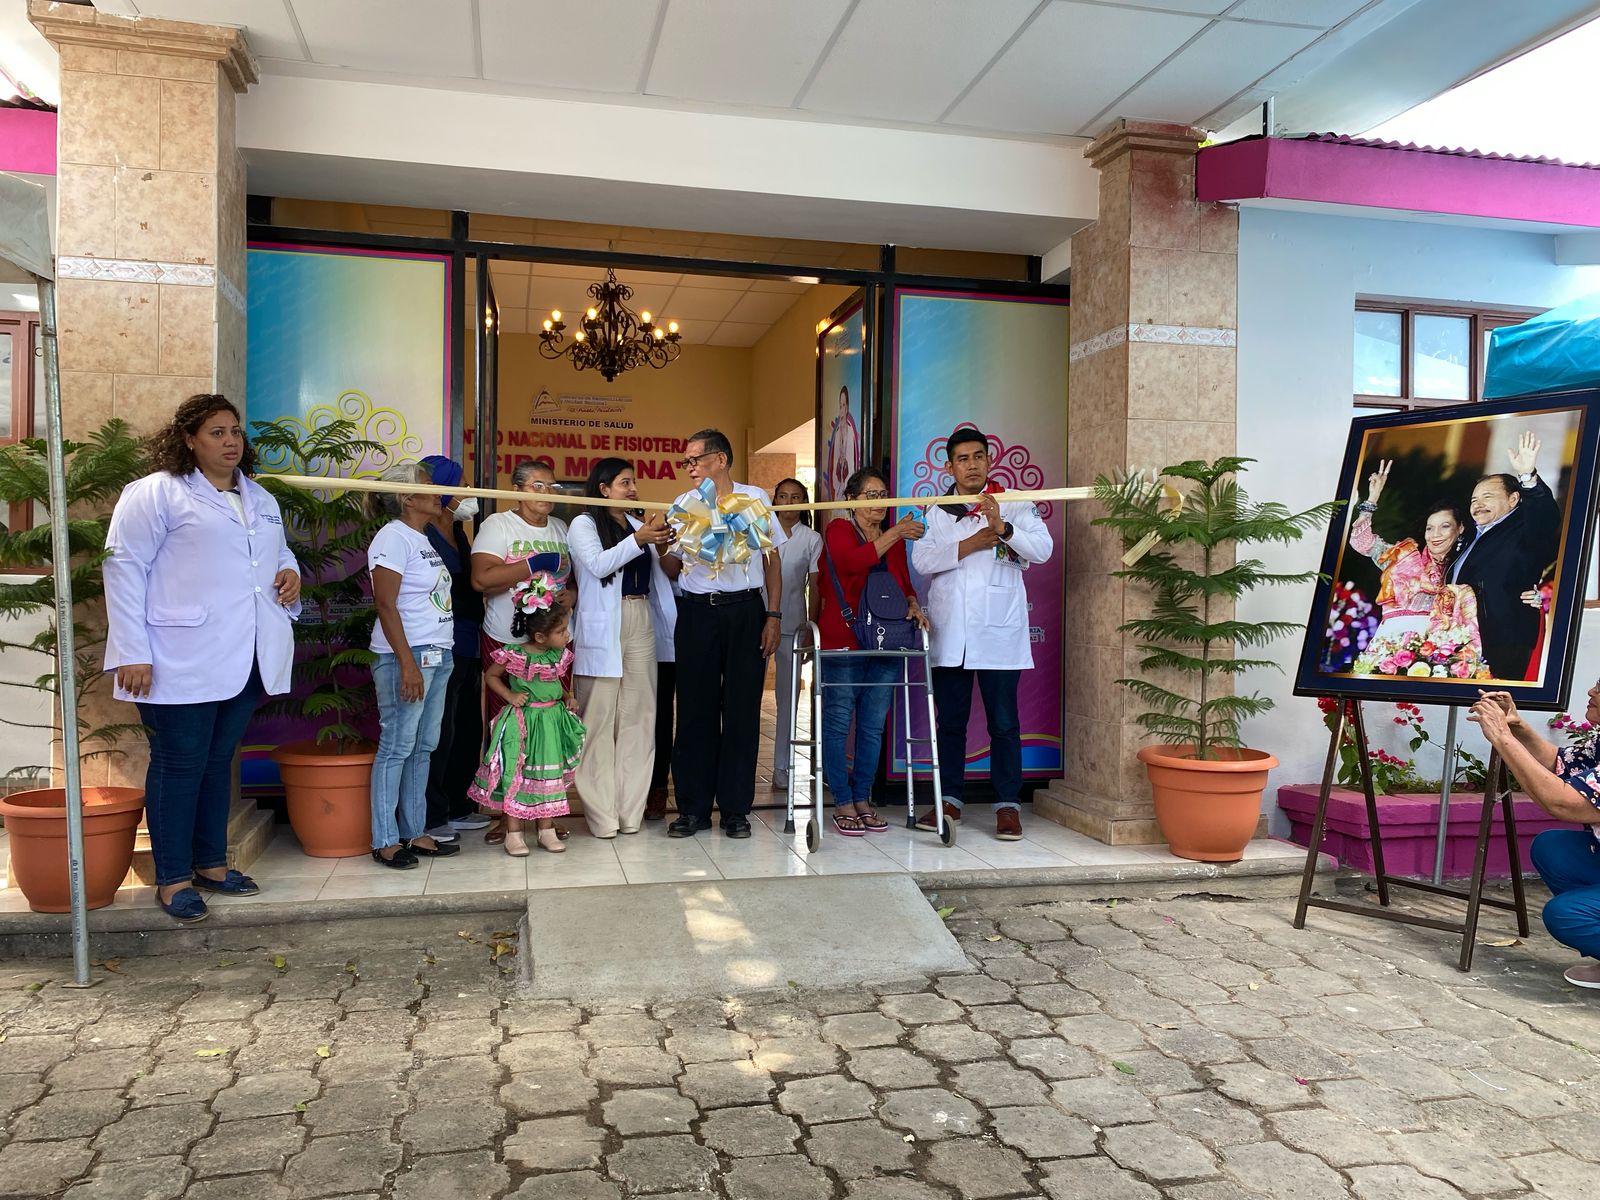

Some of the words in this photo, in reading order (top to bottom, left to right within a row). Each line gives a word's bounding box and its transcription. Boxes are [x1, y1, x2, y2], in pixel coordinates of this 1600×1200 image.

[531, 418, 586, 427] MINISTERIO
[588, 420, 601, 428] DE
[604, 421, 634, 429] SALUD
[508, 431, 587, 449] NACIONAL
[591, 434, 610, 450] DE
[614, 436, 688, 453] FISIOTERA
